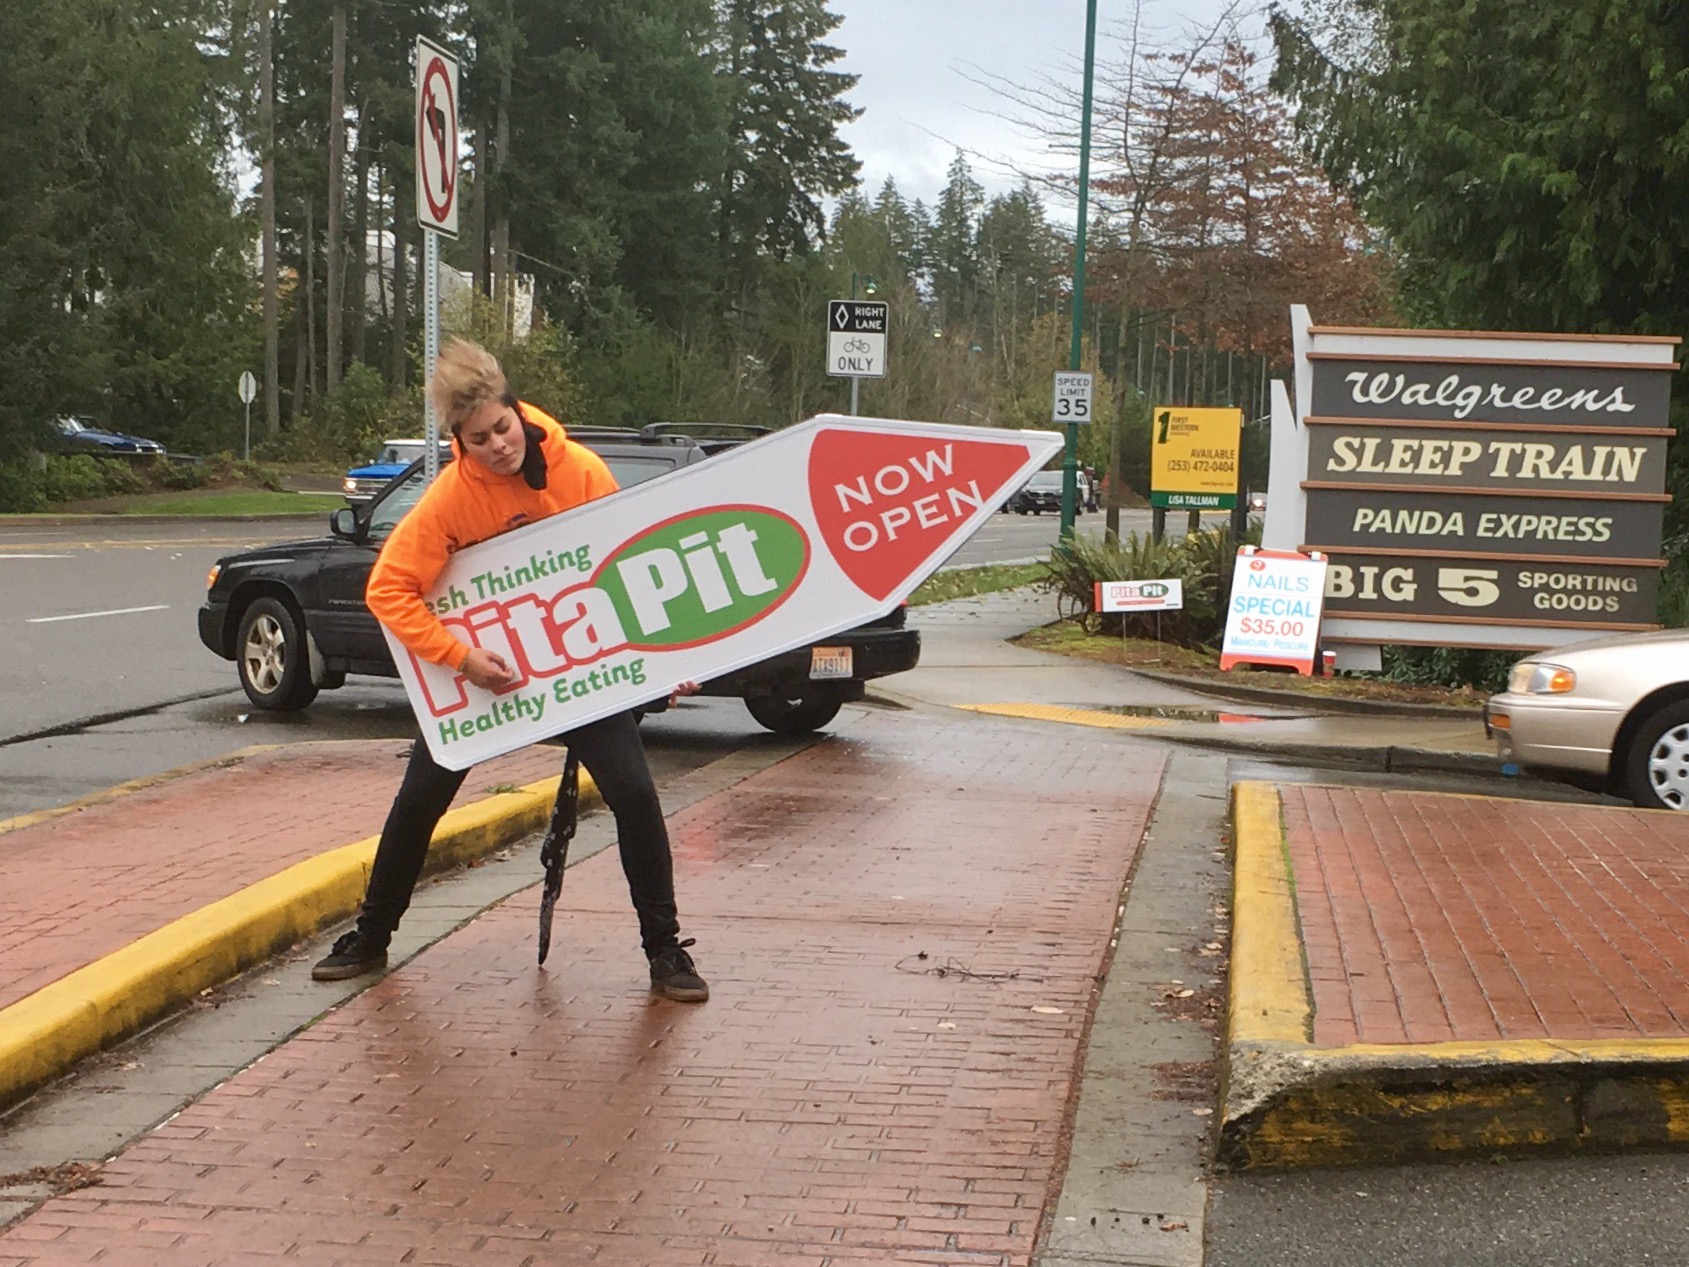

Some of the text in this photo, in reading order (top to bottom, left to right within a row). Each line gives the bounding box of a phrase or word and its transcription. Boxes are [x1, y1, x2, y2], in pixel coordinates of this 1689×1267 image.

[854, 306, 885, 317] RIGHT
[855, 319, 883, 330] LANE
[838, 356, 874, 371] ONLY
[1057, 377, 1090, 387] SPEED
[1060, 388, 1086, 396] LIMIT
[1345, 371, 1636, 419] Walgreens
[1056, 398, 1088, 417] 35
[1190, 448, 1235, 460] AVAILABLE
[1326, 435, 1648, 482] SLEEP TRAIN
[1167, 460, 1235, 473] (253) 472-0404
[834, 443, 953, 513] NOW
[1168, 494, 1220, 506] LISA TALLMAN
[843, 479, 985, 552] OPEN
[1352, 508, 1614, 543] PANDA EXPRESS
[470, 544, 593, 600] Thinking
[1517, 571, 1638, 593] SPORTING
[1248, 573, 1309, 592] NAILS
[1324, 564, 1500, 607] BIG 5
[1233, 595, 1315, 618] SPECIAL
[1533, 592, 1620, 612] GOODS
[1240, 616, 1304, 637] $35.00
[438, 658, 647, 745] Healthy Eating
